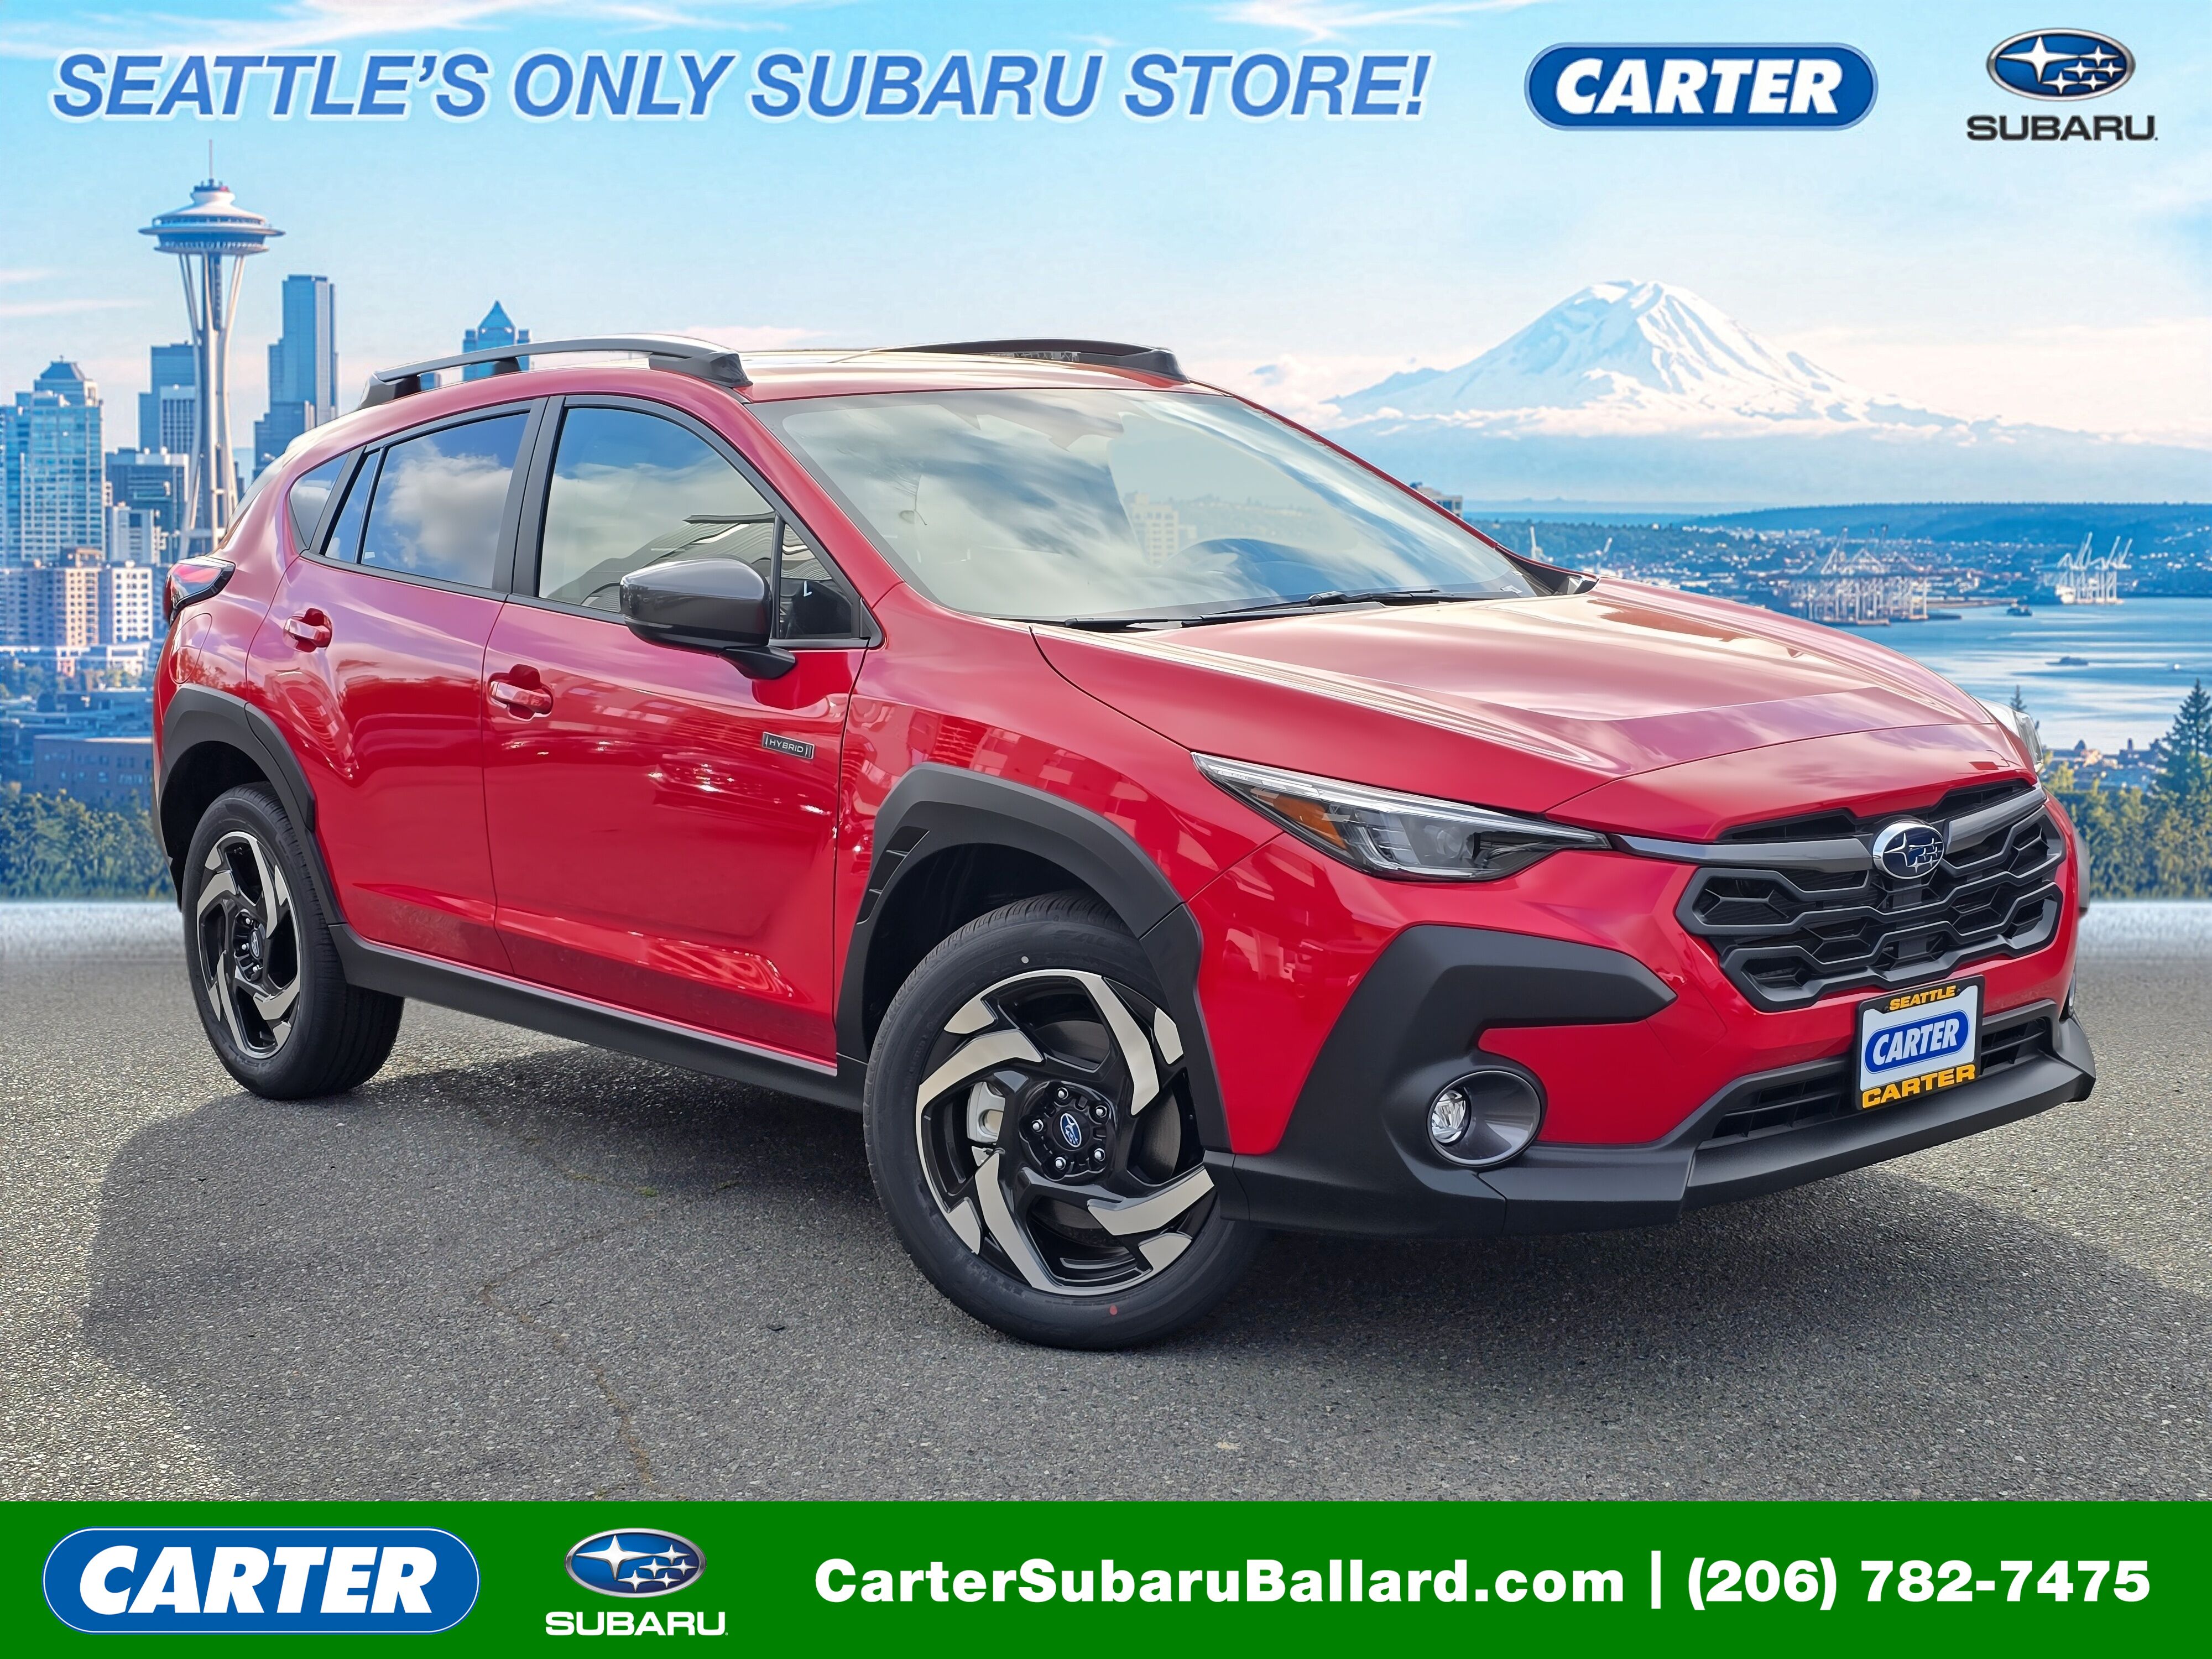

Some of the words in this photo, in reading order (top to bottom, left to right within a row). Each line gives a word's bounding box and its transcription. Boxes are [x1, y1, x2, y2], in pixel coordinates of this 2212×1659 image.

[769, 738, 804, 753] HYBRID
[1889, 985, 1957, 1011] SEATTLE
[1872, 1018, 1960, 1066] CARTER
[1862, 1063, 1976, 1109] CARTER
